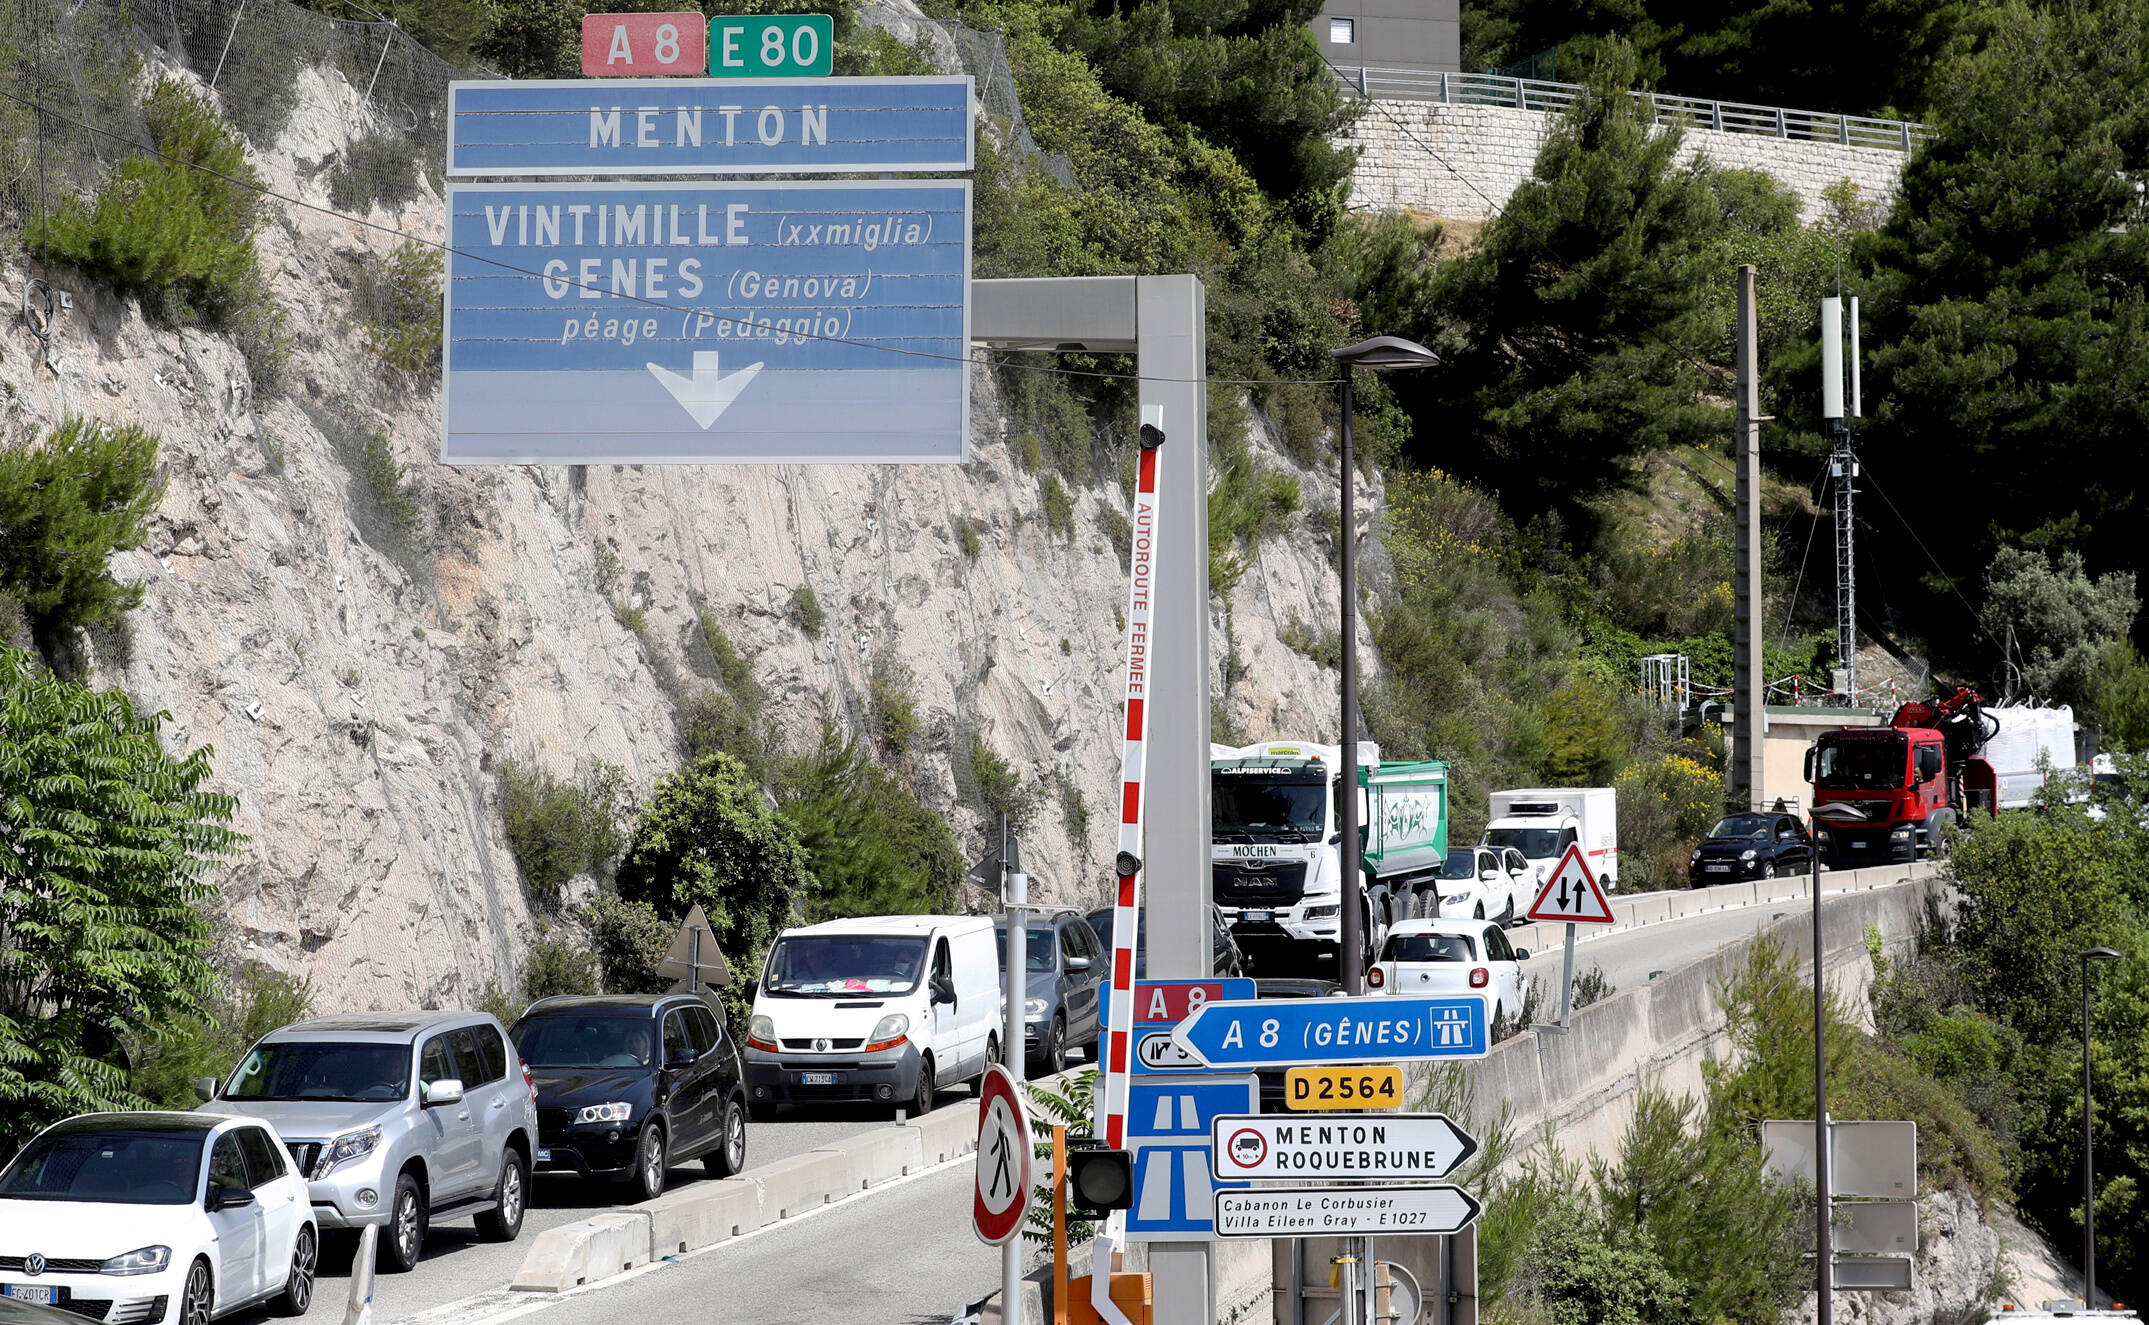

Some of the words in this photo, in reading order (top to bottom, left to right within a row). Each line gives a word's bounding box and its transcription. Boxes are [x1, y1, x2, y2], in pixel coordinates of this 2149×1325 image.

[607, 25, 633, 65] A
[654, 23, 680, 65] 8
[722, 27, 744, 68] E
[760, 25, 819, 67] 80
[589, 105, 828, 148] MENTON
[485, 204, 750, 246] VINTIMILLE
[776, 214, 933, 252] (xxmiglia)
[542, 258, 703, 300] GENES
[727, 268, 872, 300] (Genova)
[561, 311, 659, 346] péage
[681, 309, 852, 345] (Pedaggio)
[1133, 502, 1152, 611] AUTOROUTE
[1129, 622, 1146, 694] FERMEE
[1232, 767, 1281, 775] ALPISERVICE
[1232, 845, 1277, 857] MOCHEN
[1147, 987, 1169, 1019] A
[1187, 986, 1207, 1017] 8
[1221, 1020, 1245, 1050] A
[1258, 1018, 1281, 1048] 8
[1303, 1016, 1423, 1050] (GÊNES)
[1294, 1078, 1310, 1100] D
[1318, 1075, 1396, 1100] 2564
[1276, 1126, 1387, 1145] MENTON
[1276, 1151, 1437, 1170] ROQUEBRUNE
[1223, 1199, 1290, 1213] Cabanon
[1297, 1198, 1313, 1211] Le
[1320, 1197, 1395, 1211] Corbusier
[1224, 1214, 1260, 1229] Villa
[1267, 1213, 1315, 1228] Eileen
[1322, 1213, 1357, 1230] Gray
